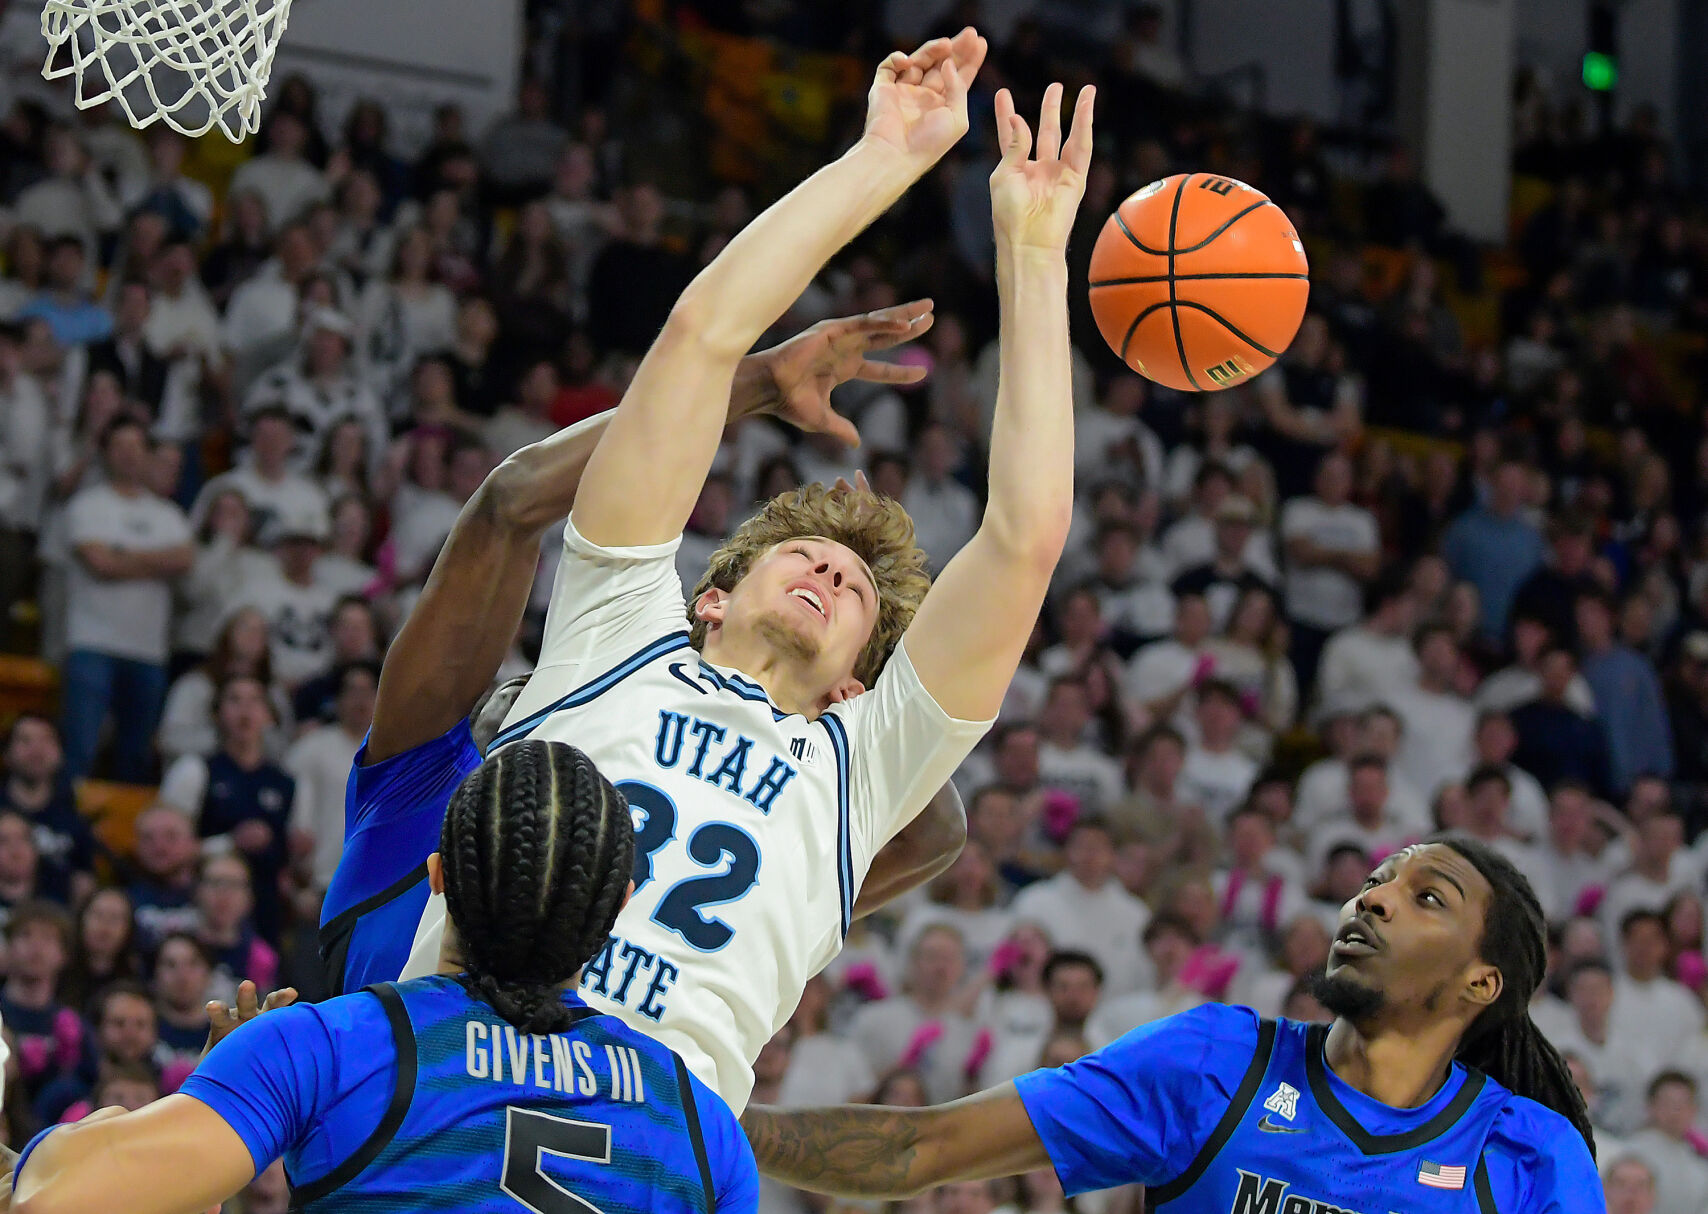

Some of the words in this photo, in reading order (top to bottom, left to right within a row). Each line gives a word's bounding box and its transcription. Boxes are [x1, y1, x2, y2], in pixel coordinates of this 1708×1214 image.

[654, 709, 798, 816] UTAH
[581, 935, 679, 1023] ATE
[465, 1020, 598, 1097] GIVENS
[604, 1044, 645, 1103] III
[499, 1105, 612, 1214] 5
